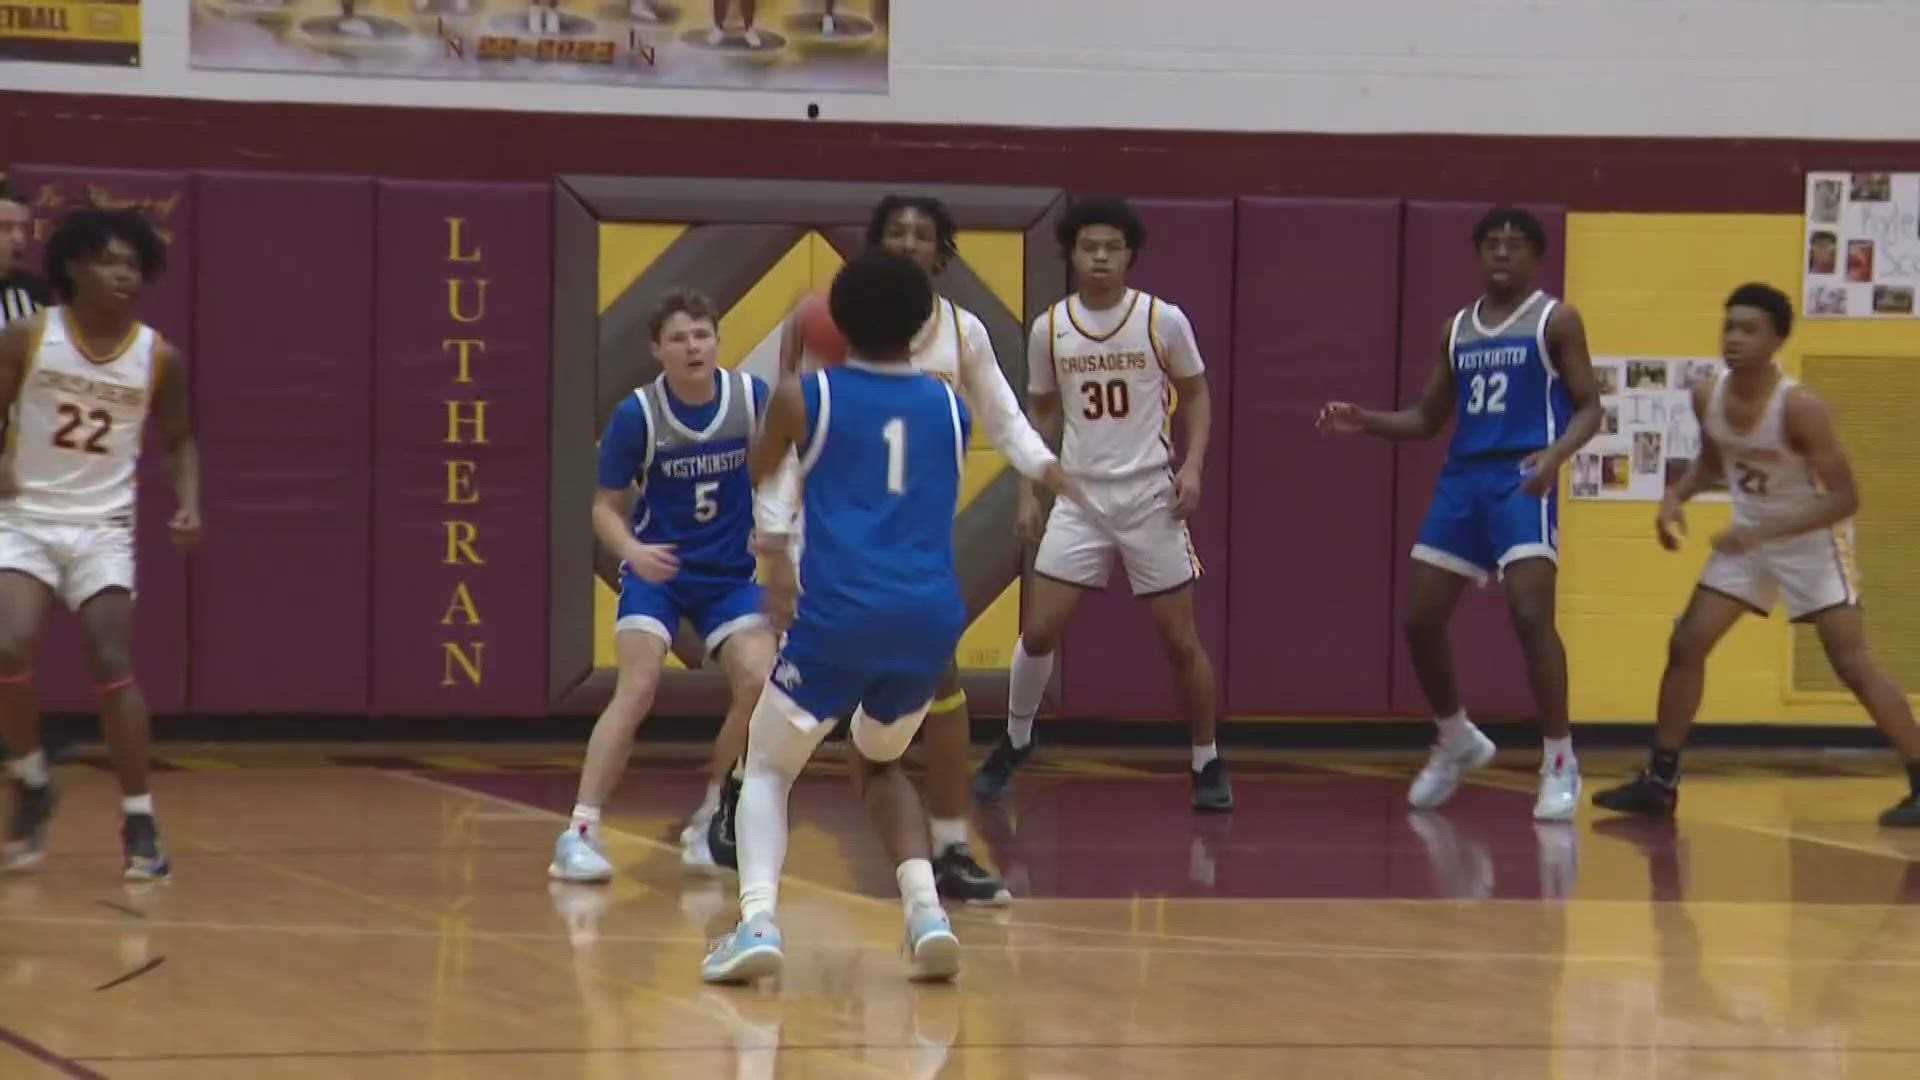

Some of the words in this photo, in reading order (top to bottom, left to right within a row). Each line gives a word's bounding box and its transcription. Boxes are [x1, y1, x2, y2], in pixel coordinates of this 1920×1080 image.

[1060, 351, 1146, 374] CRUSADERS
[1080, 379, 1130, 420] 30
[1466, 372, 1509, 415] 32
[53, 403, 113, 453] 22
[441, 216, 493, 688] LUTHERAN
[881, 416, 906, 495] 1
[693, 481, 719, 523] 5
